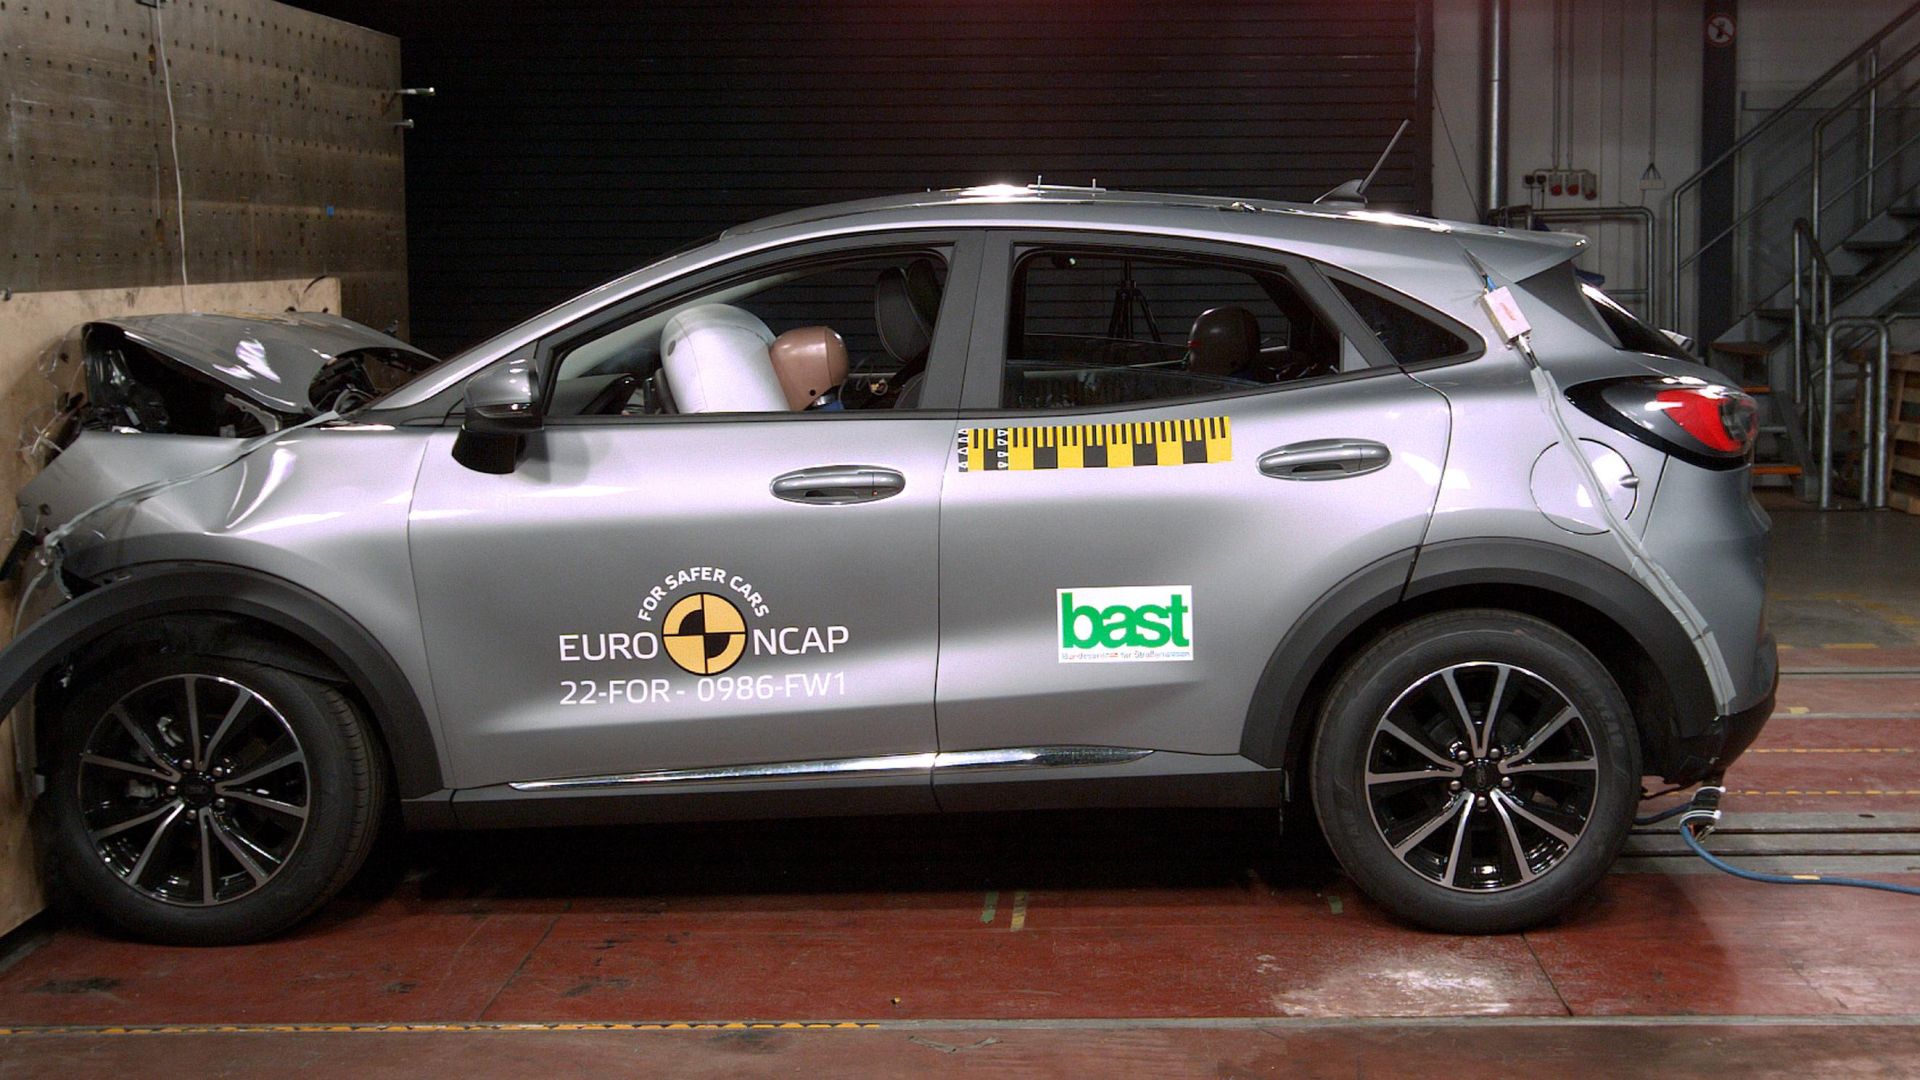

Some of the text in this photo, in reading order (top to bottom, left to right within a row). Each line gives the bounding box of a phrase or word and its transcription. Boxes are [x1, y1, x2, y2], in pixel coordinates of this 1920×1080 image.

[638, 566, 770, 622] FOR SAFER CARS
[1061, 591, 1190, 649] bast
[558, 625, 850, 662] EURO NCAP
[697, 671, 846, 702] 0986-FW1
